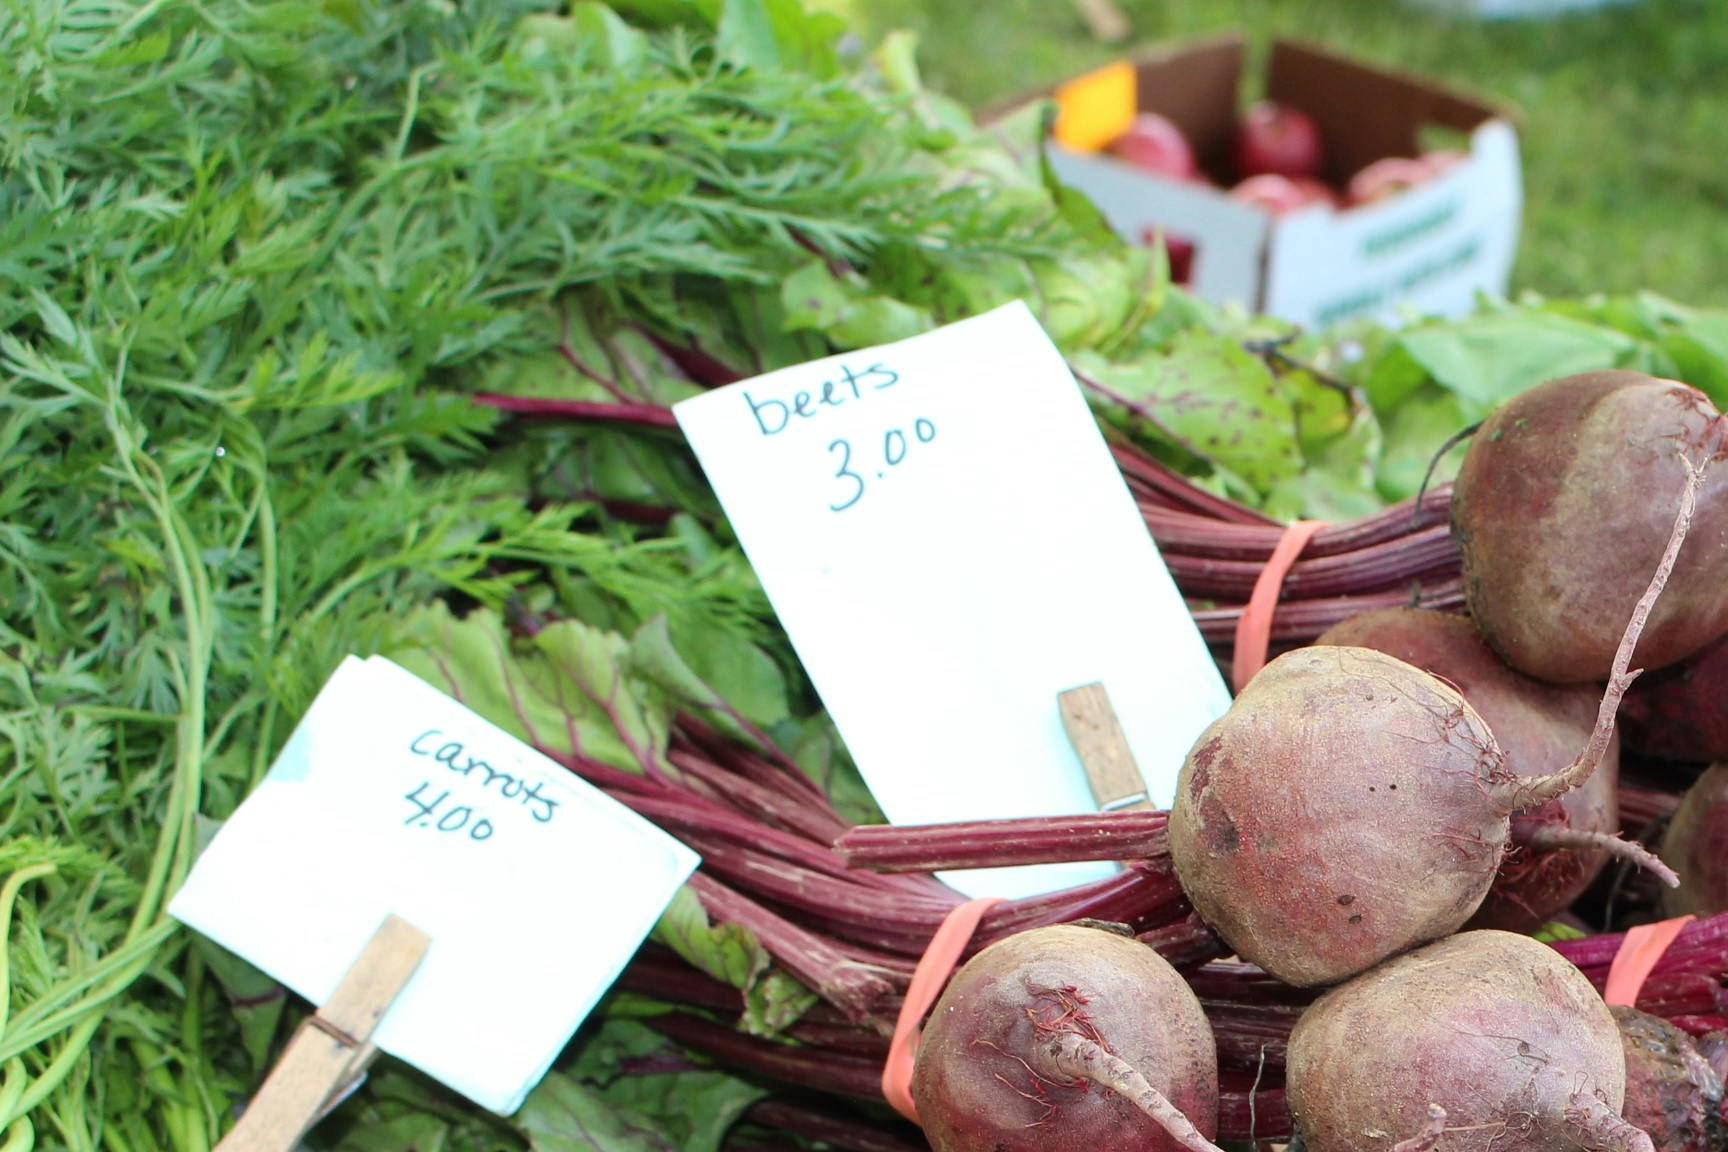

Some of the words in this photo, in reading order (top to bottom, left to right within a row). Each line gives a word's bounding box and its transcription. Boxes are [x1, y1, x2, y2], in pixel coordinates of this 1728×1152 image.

[743, 362, 899, 436] beets
[828, 418, 936, 512] 3.00
[404, 781, 494, 841] 4.00
[410, 729, 560, 823] carrots
